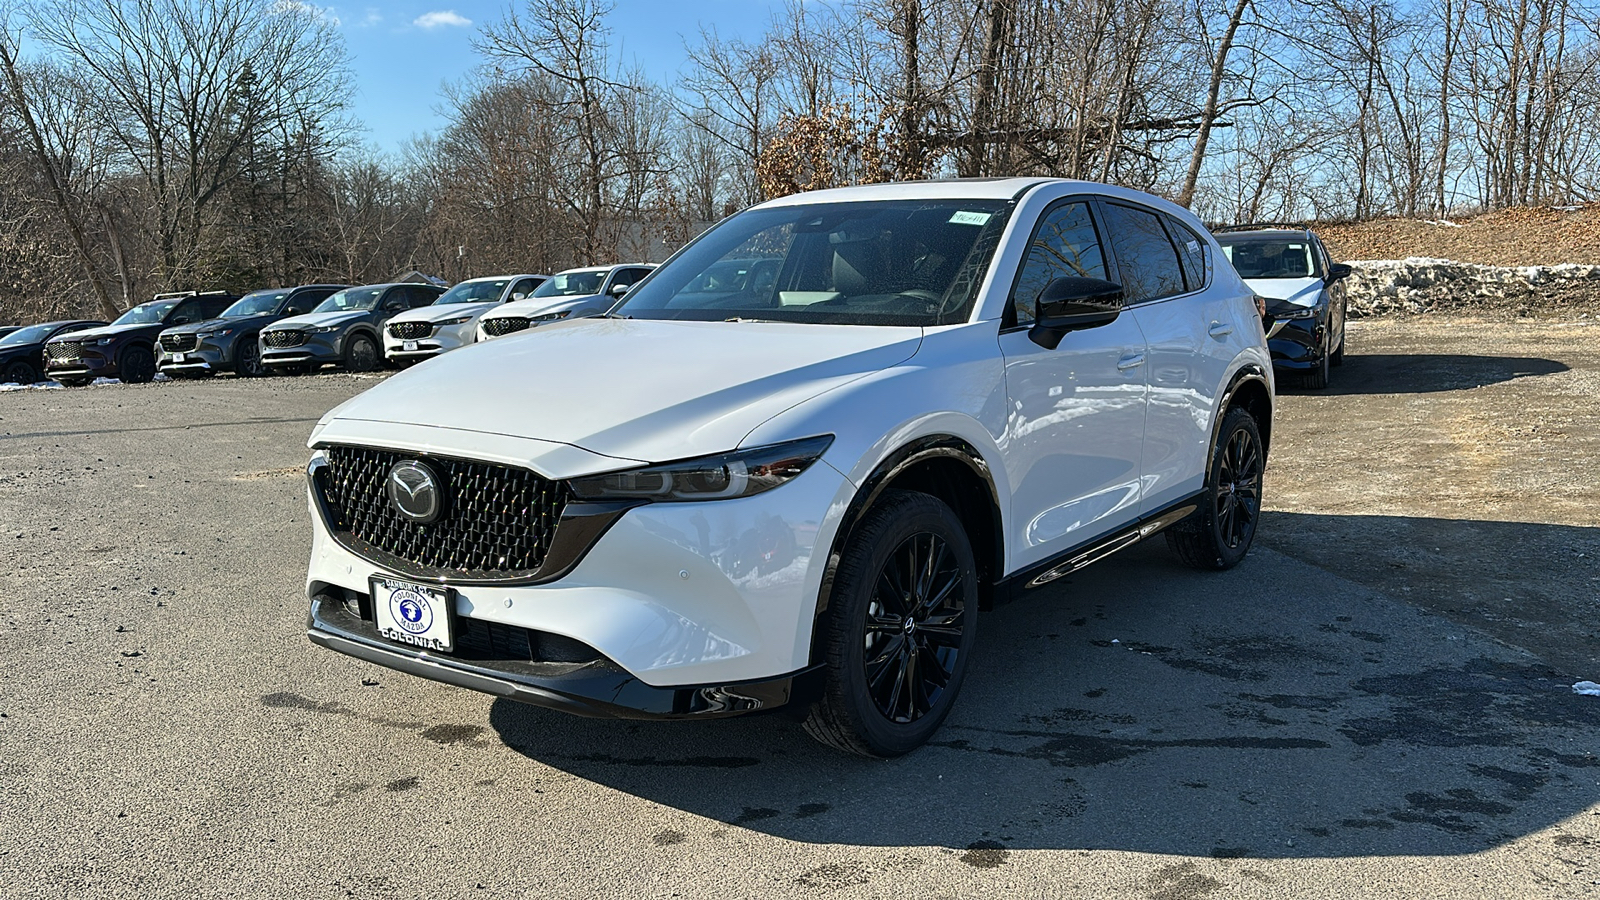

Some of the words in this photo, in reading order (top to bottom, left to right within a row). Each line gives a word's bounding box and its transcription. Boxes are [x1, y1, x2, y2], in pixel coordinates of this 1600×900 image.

[395, 590, 427, 610] COLONIAL
[400, 617, 425, 631] MAZDA
[381, 630, 444, 651] COLONIAL
